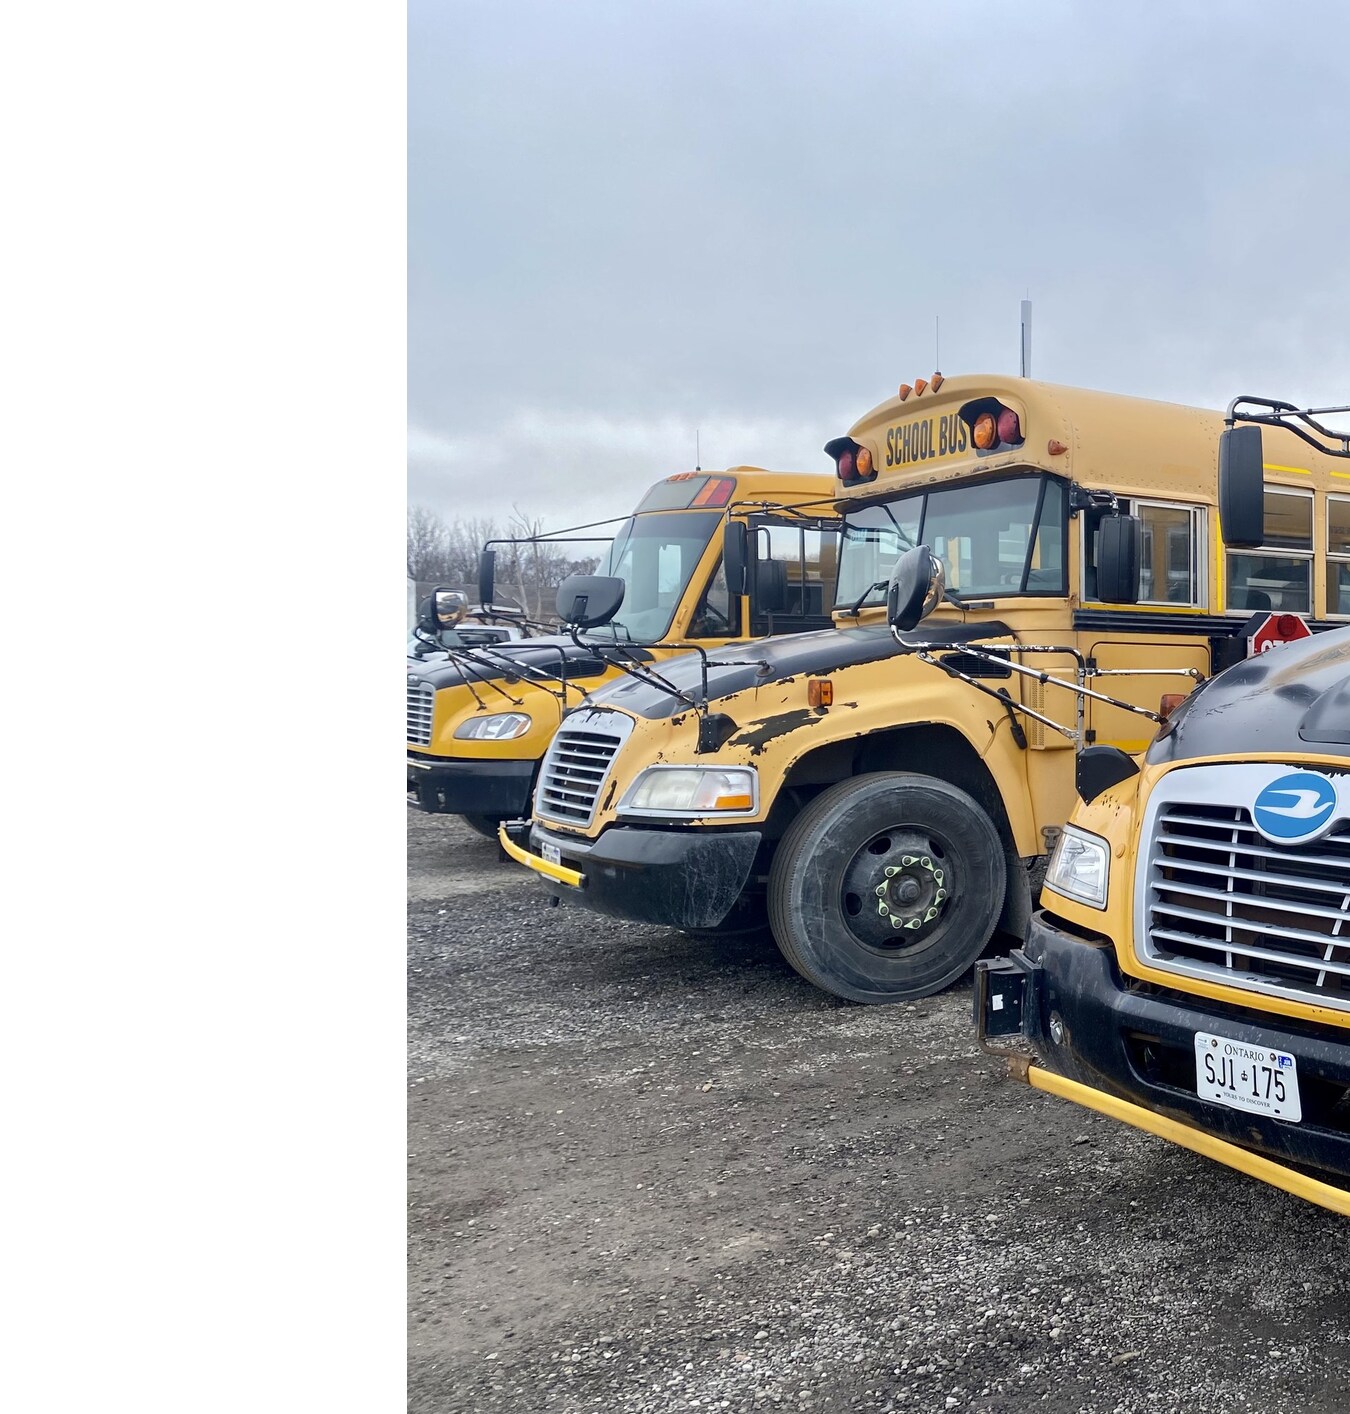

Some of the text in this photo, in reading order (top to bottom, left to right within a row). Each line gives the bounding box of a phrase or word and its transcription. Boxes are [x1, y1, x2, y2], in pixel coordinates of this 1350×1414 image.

[886, 413, 967, 467] SCHOOL BUS
[1224, 1043, 1265, 1062] ONTARIO
[1204, 1053, 1286, 1103] SJ1 175
[1223, 1091, 1238, 1100] YOURS
[1246, 1097, 1271, 1108] DISCOVER
